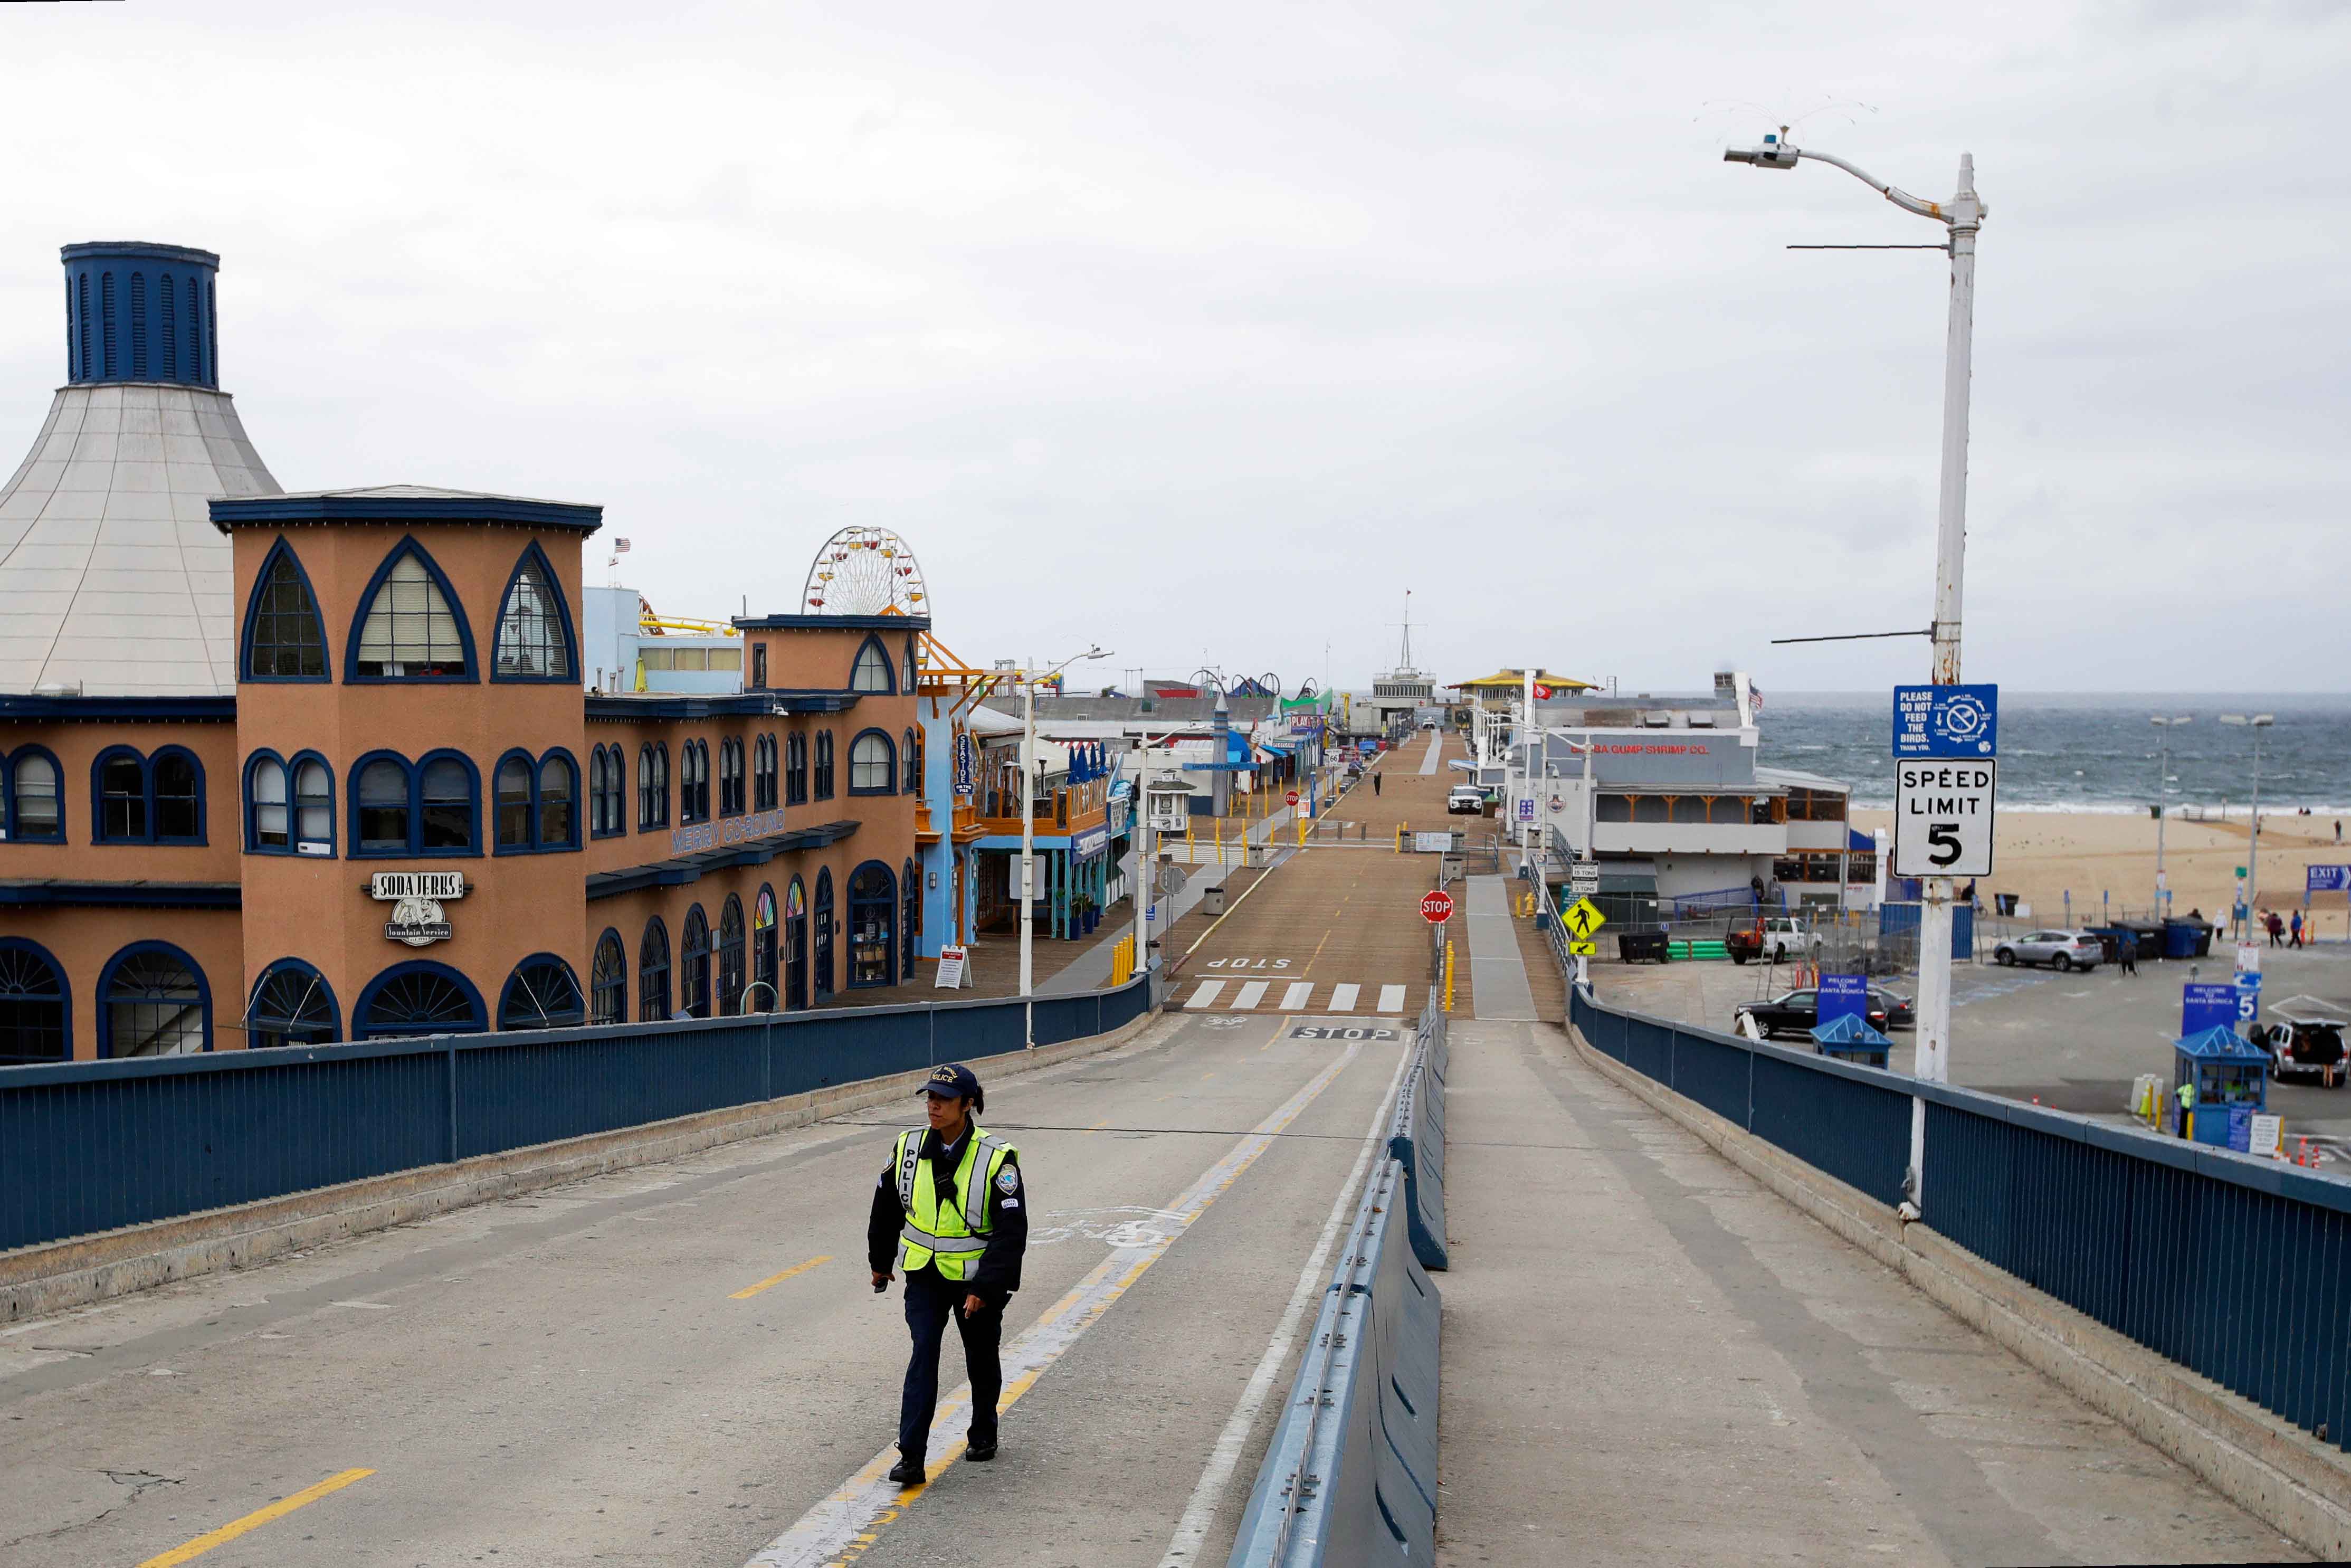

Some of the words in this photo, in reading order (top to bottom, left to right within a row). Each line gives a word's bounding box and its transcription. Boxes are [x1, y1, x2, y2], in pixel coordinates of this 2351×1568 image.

[1900, 692, 1933, 701] PLEASE
[1900, 702, 1912, 712] DO
[1914, 702, 1932, 712] NOT
[1292, 716, 1308, 727] PLAY
[1905, 713, 1927, 723] FEED
[1907, 724, 1924, 733] THE
[1900, 734, 1930, 743] BIRDS.
[1611, 745, 1643, 754] GUMP
[1646, 745, 1687, 754] SHRIMP
[1690, 746, 1710, 755] CO.
[1903, 771, 1989, 788] SPEED
[1910, 797, 1980, 814] LIMIT
[672, 821, 720, 855] MERRY
[724, 808, 786, 843] GO-ROUND
[1928, 823, 1962, 866] 5
[2310, 867, 2338, 879] EXIT
[380, 876, 413, 896] SODA
[416, 875, 455, 896] JERKS
[1423, 900, 1451, 913] STOP
[1207, 958, 1292, 968] STOP
[2239, 995, 2254, 1017] 5
[1298, 1027, 1392, 1040] STOP
[932, 1073, 954, 1083] POLICE
